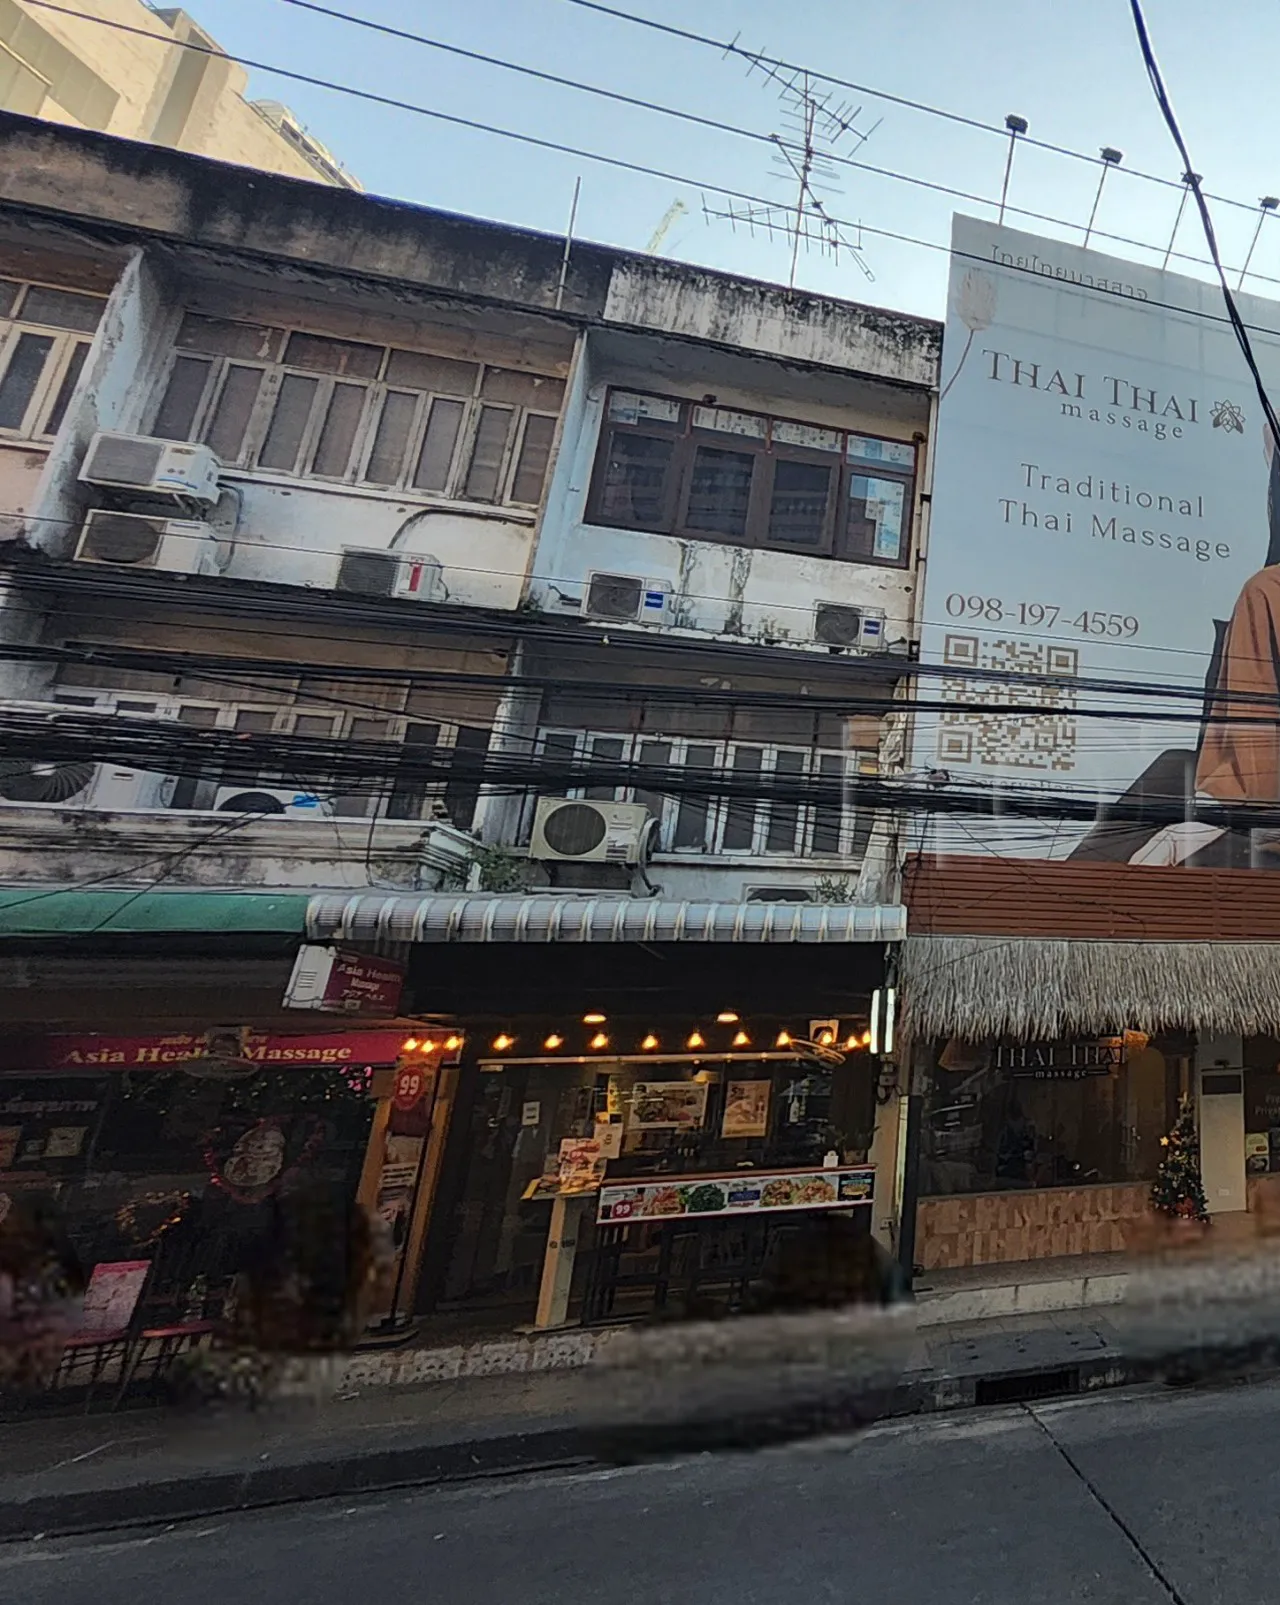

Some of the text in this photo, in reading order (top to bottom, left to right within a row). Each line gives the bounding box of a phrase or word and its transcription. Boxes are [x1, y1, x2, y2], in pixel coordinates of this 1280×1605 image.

[982, 349, 1199, 424] THAI THAI
[1060, 402, 1184, 441] massage
[1021, 463, 1204, 518] Traditional
[999, 498, 1231, 562] Thai Massage
[945, 593, 1140, 638] 098-197-4559
[66, 1048, 125, 1064] Asia
[243, 1045, 352, 1063] Massage
[996, 1043, 1128, 1068] THAI THAI
[399, 1074, 420, 1096] 99
[1033, 1069, 1088, 1080] massage
[615, 1203, 631, 1215] 99
